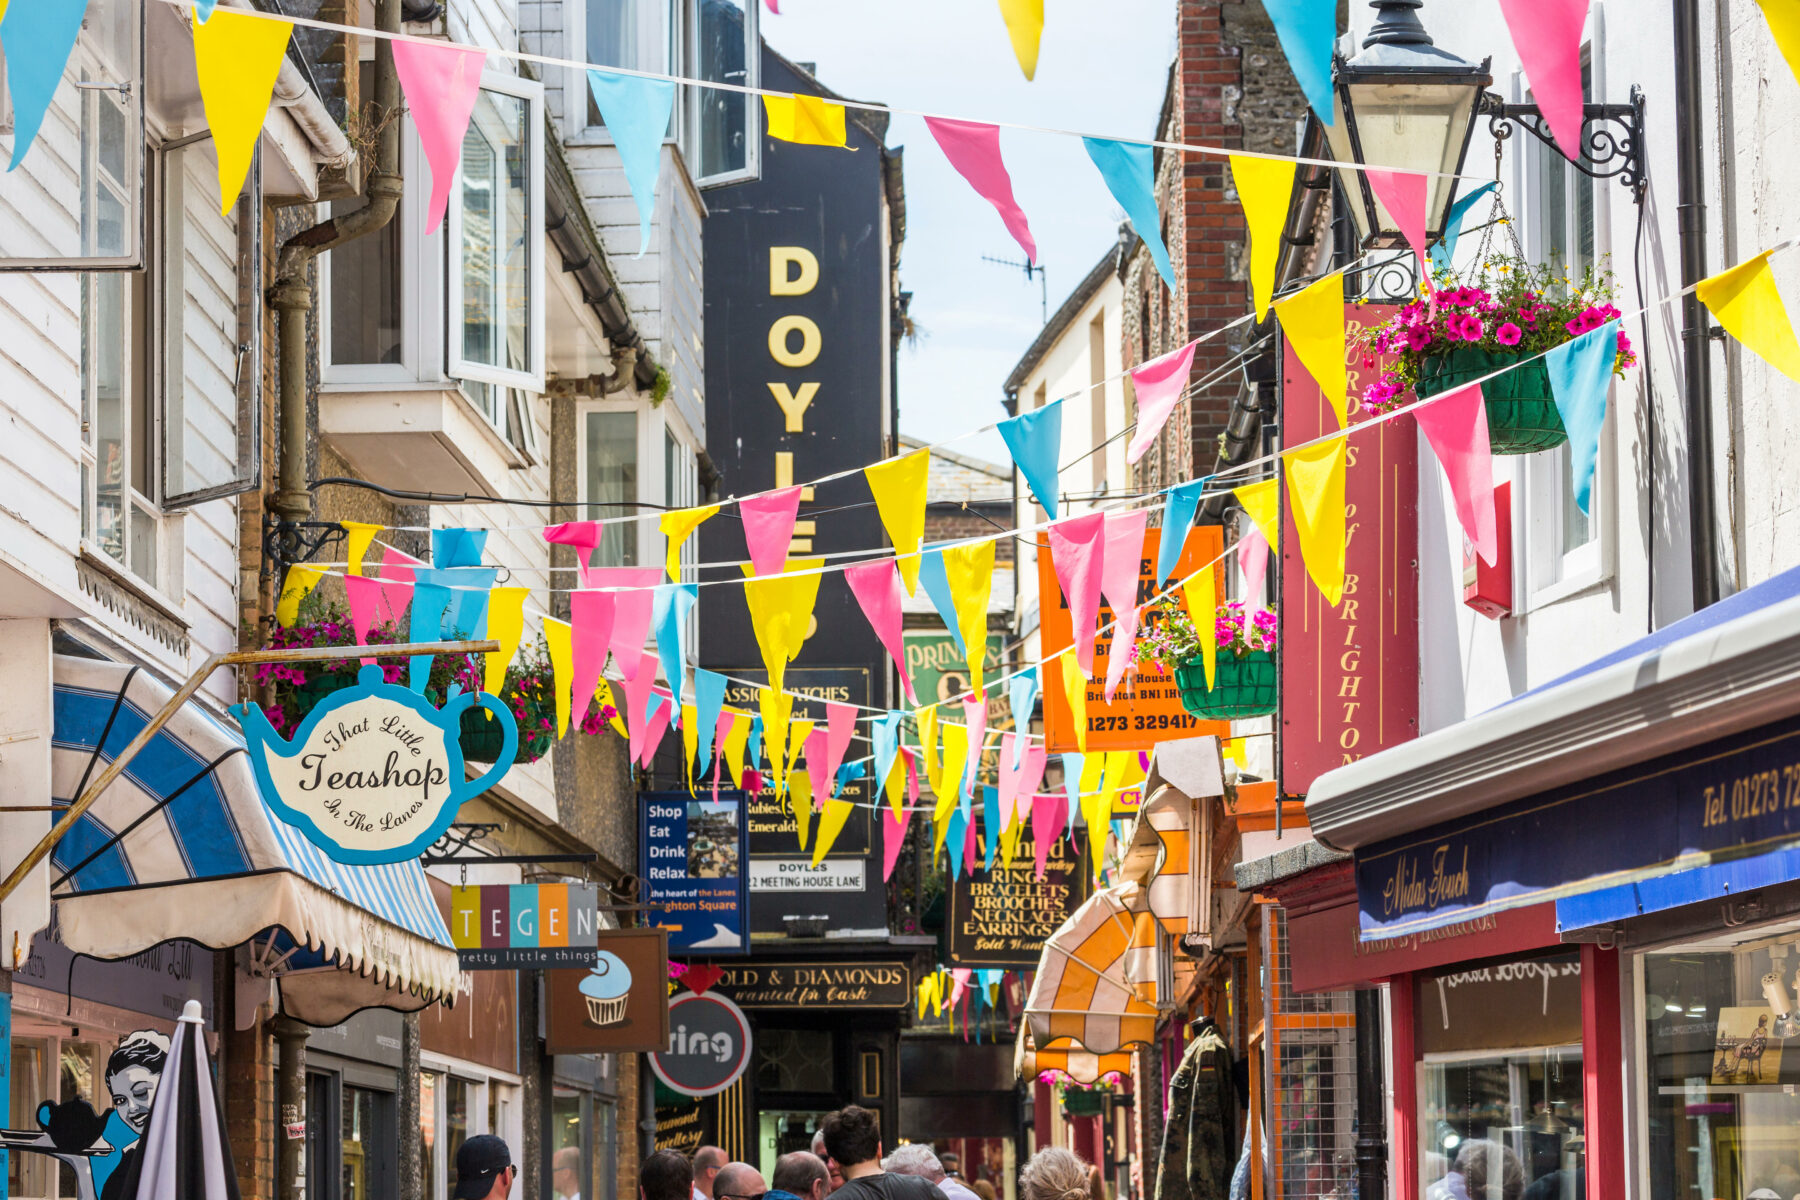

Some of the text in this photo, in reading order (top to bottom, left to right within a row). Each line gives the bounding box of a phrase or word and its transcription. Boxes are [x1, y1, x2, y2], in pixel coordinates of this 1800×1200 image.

[767, 246, 823, 641] DOYL
[1136, 674, 1172, 684] House
[1088, 714, 1198, 731] 1273 329417
[323, 715, 426, 758] That Little
[299, 750, 448, 800] Teashop
[1703, 782, 1728, 828] Tel.
[1731, 768, 1780, 821] 01273
[323, 797, 424, 833] In The Lanes
[648, 804, 683, 820] Shop
[649, 825, 671, 838] Eat
[649, 845, 686, 859] Drink
[649, 866, 686, 880] Relax
[778, 863, 828, 872] DOYLES
[760, 876, 800, 888] MEETING
[803, 876, 834, 888] HOUSE
[836, 876, 861, 887] LANE
[991, 870, 1049, 884] RINGS
[1383, 844, 1470, 916] Midas Touch
[665, 888, 687, 897] heart
[688, 888, 698, 897] of
[698, 888, 712, 897] the
[713, 888, 736, 897] Lanes
[970, 882, 1070, 898] BRACELETS
[650, 901, 737, 914] ghton Square
[974, 896, 1065, 910] BROOCHES
[459, 907, 592, 938] TEGEN
[970, 909, 1069, 924] NECKLACES
[963, 922, 1053, 936] EARRINGS
[974, 936, 1045, 951] Gold Want
[461, 949, 597, 965] retty little things
[716, 968, 902, 986] OLD & DIAMONDS
[735, 986, 798, 1002] wanted
[655, 1106, 700, 1132] iamond
[654, 1131, 703, 1156] ewellery
